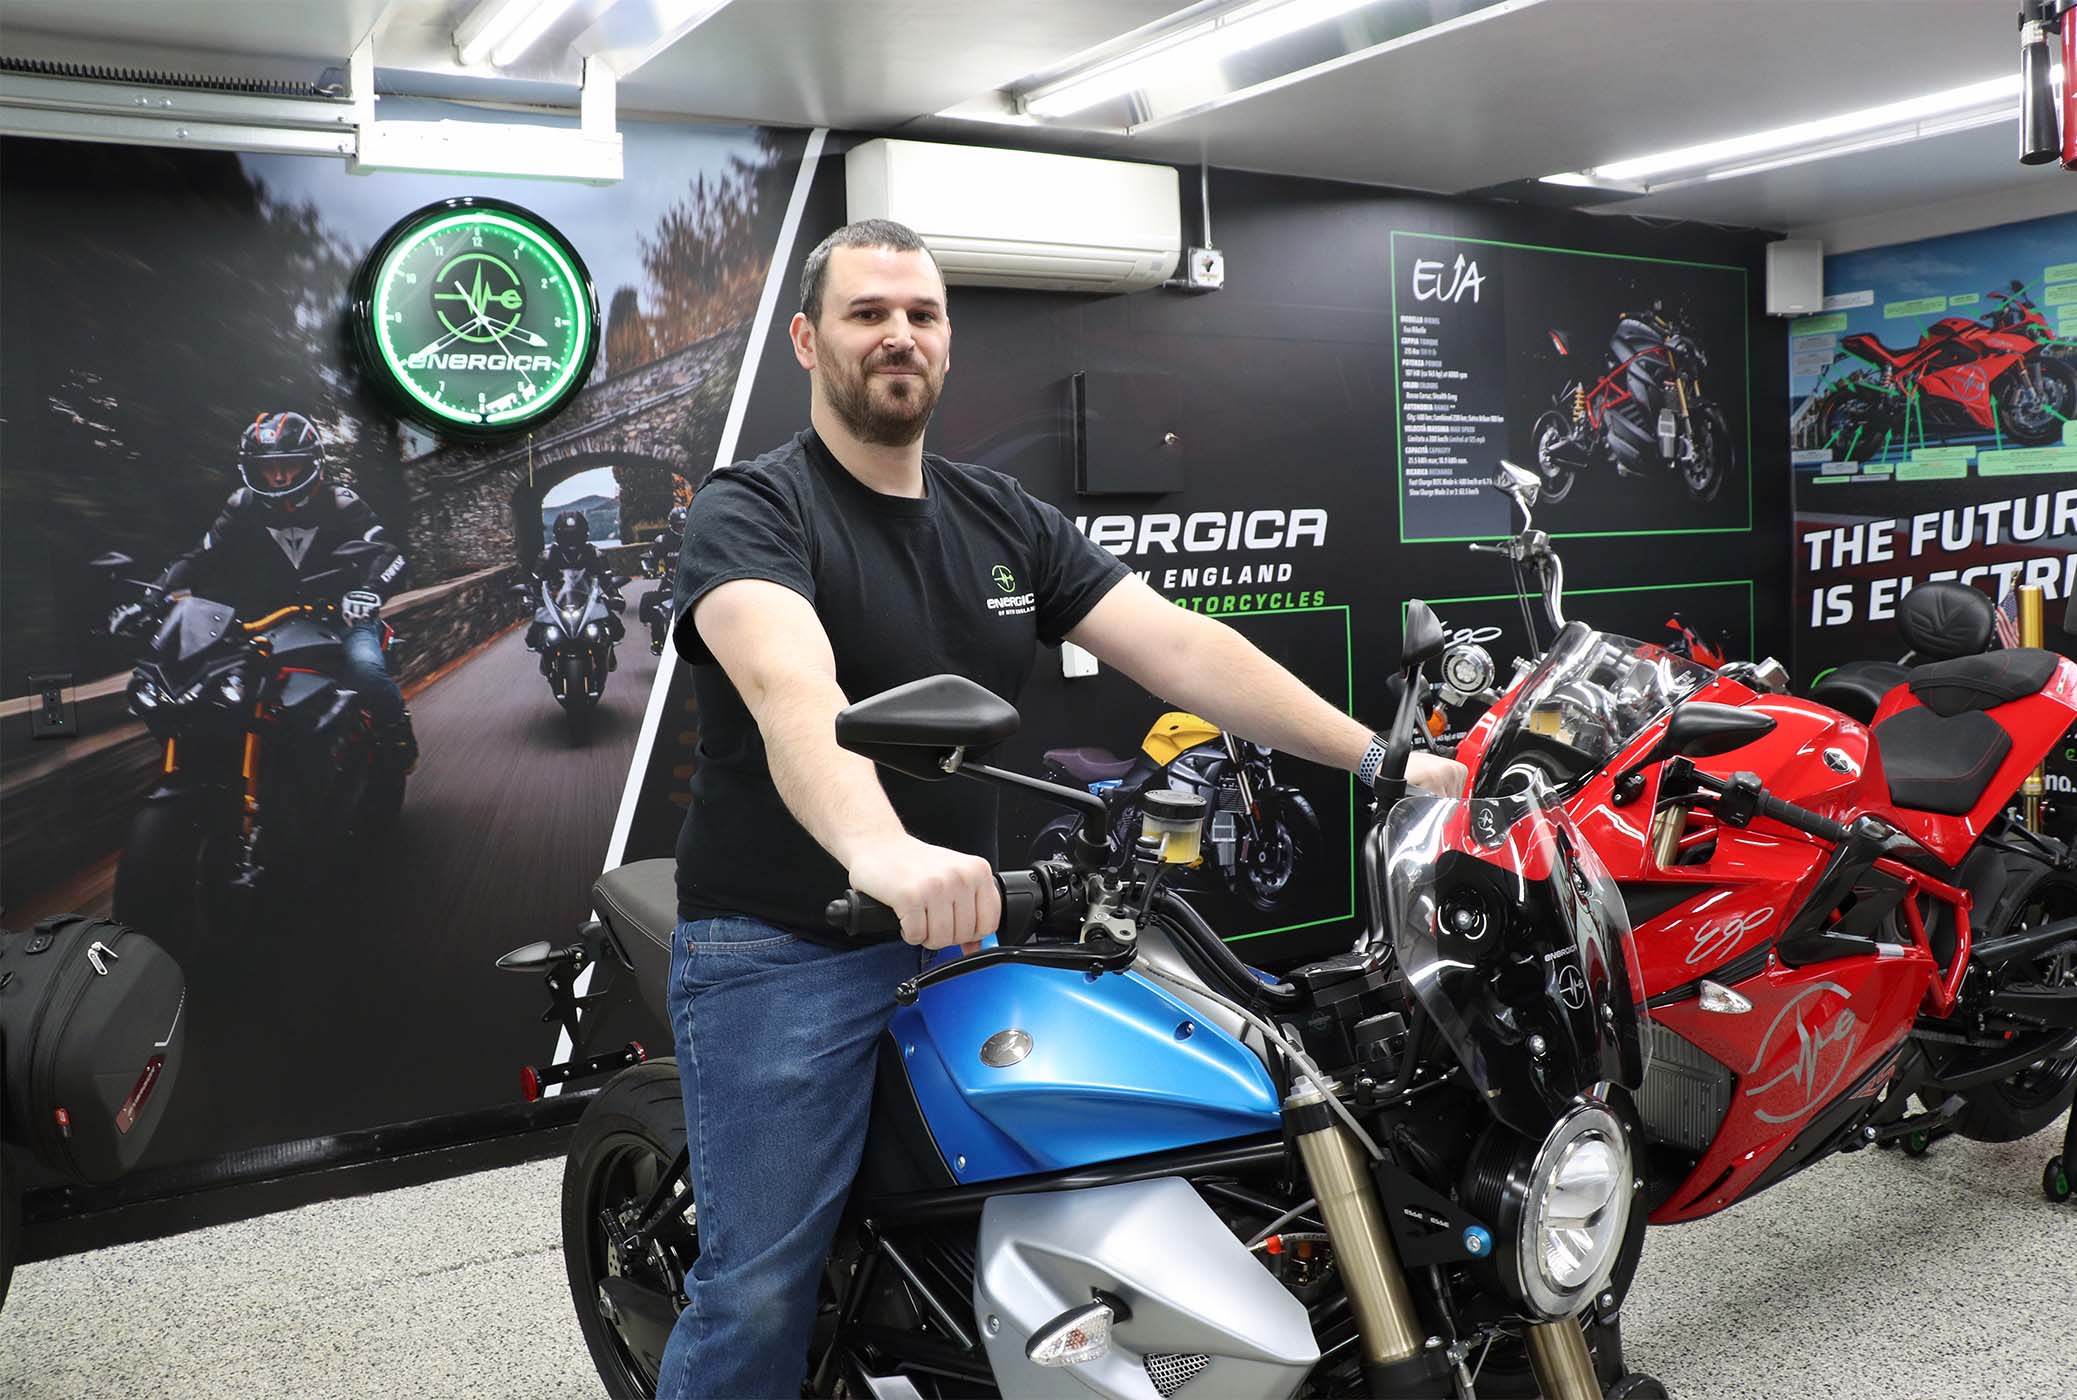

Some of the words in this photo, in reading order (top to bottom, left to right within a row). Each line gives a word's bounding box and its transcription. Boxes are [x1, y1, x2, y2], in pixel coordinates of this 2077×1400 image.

[472, 237, 483, 247] 12
[435, 247, 444, 257] 11
[513, 250, 519, 260] 1
[406, 274, 417, 284] 10
[541, 278, 548, 289] 2
[394, 312, 402, 323] 9
[554, 317, 562, 327] 3
[1074, 508, 1329, 556] ERGICA
[1803, 519, 1897, 572] THE
[1910, 489, 2077, 558] FUTUR
[1163, 563, 1293, 589] ENGLAND
[1173, 590, 1326, 614] OTORCYCLES
[1810, 584, 1853, 628] IS
[1685, 906, 1775, 964] Ego
